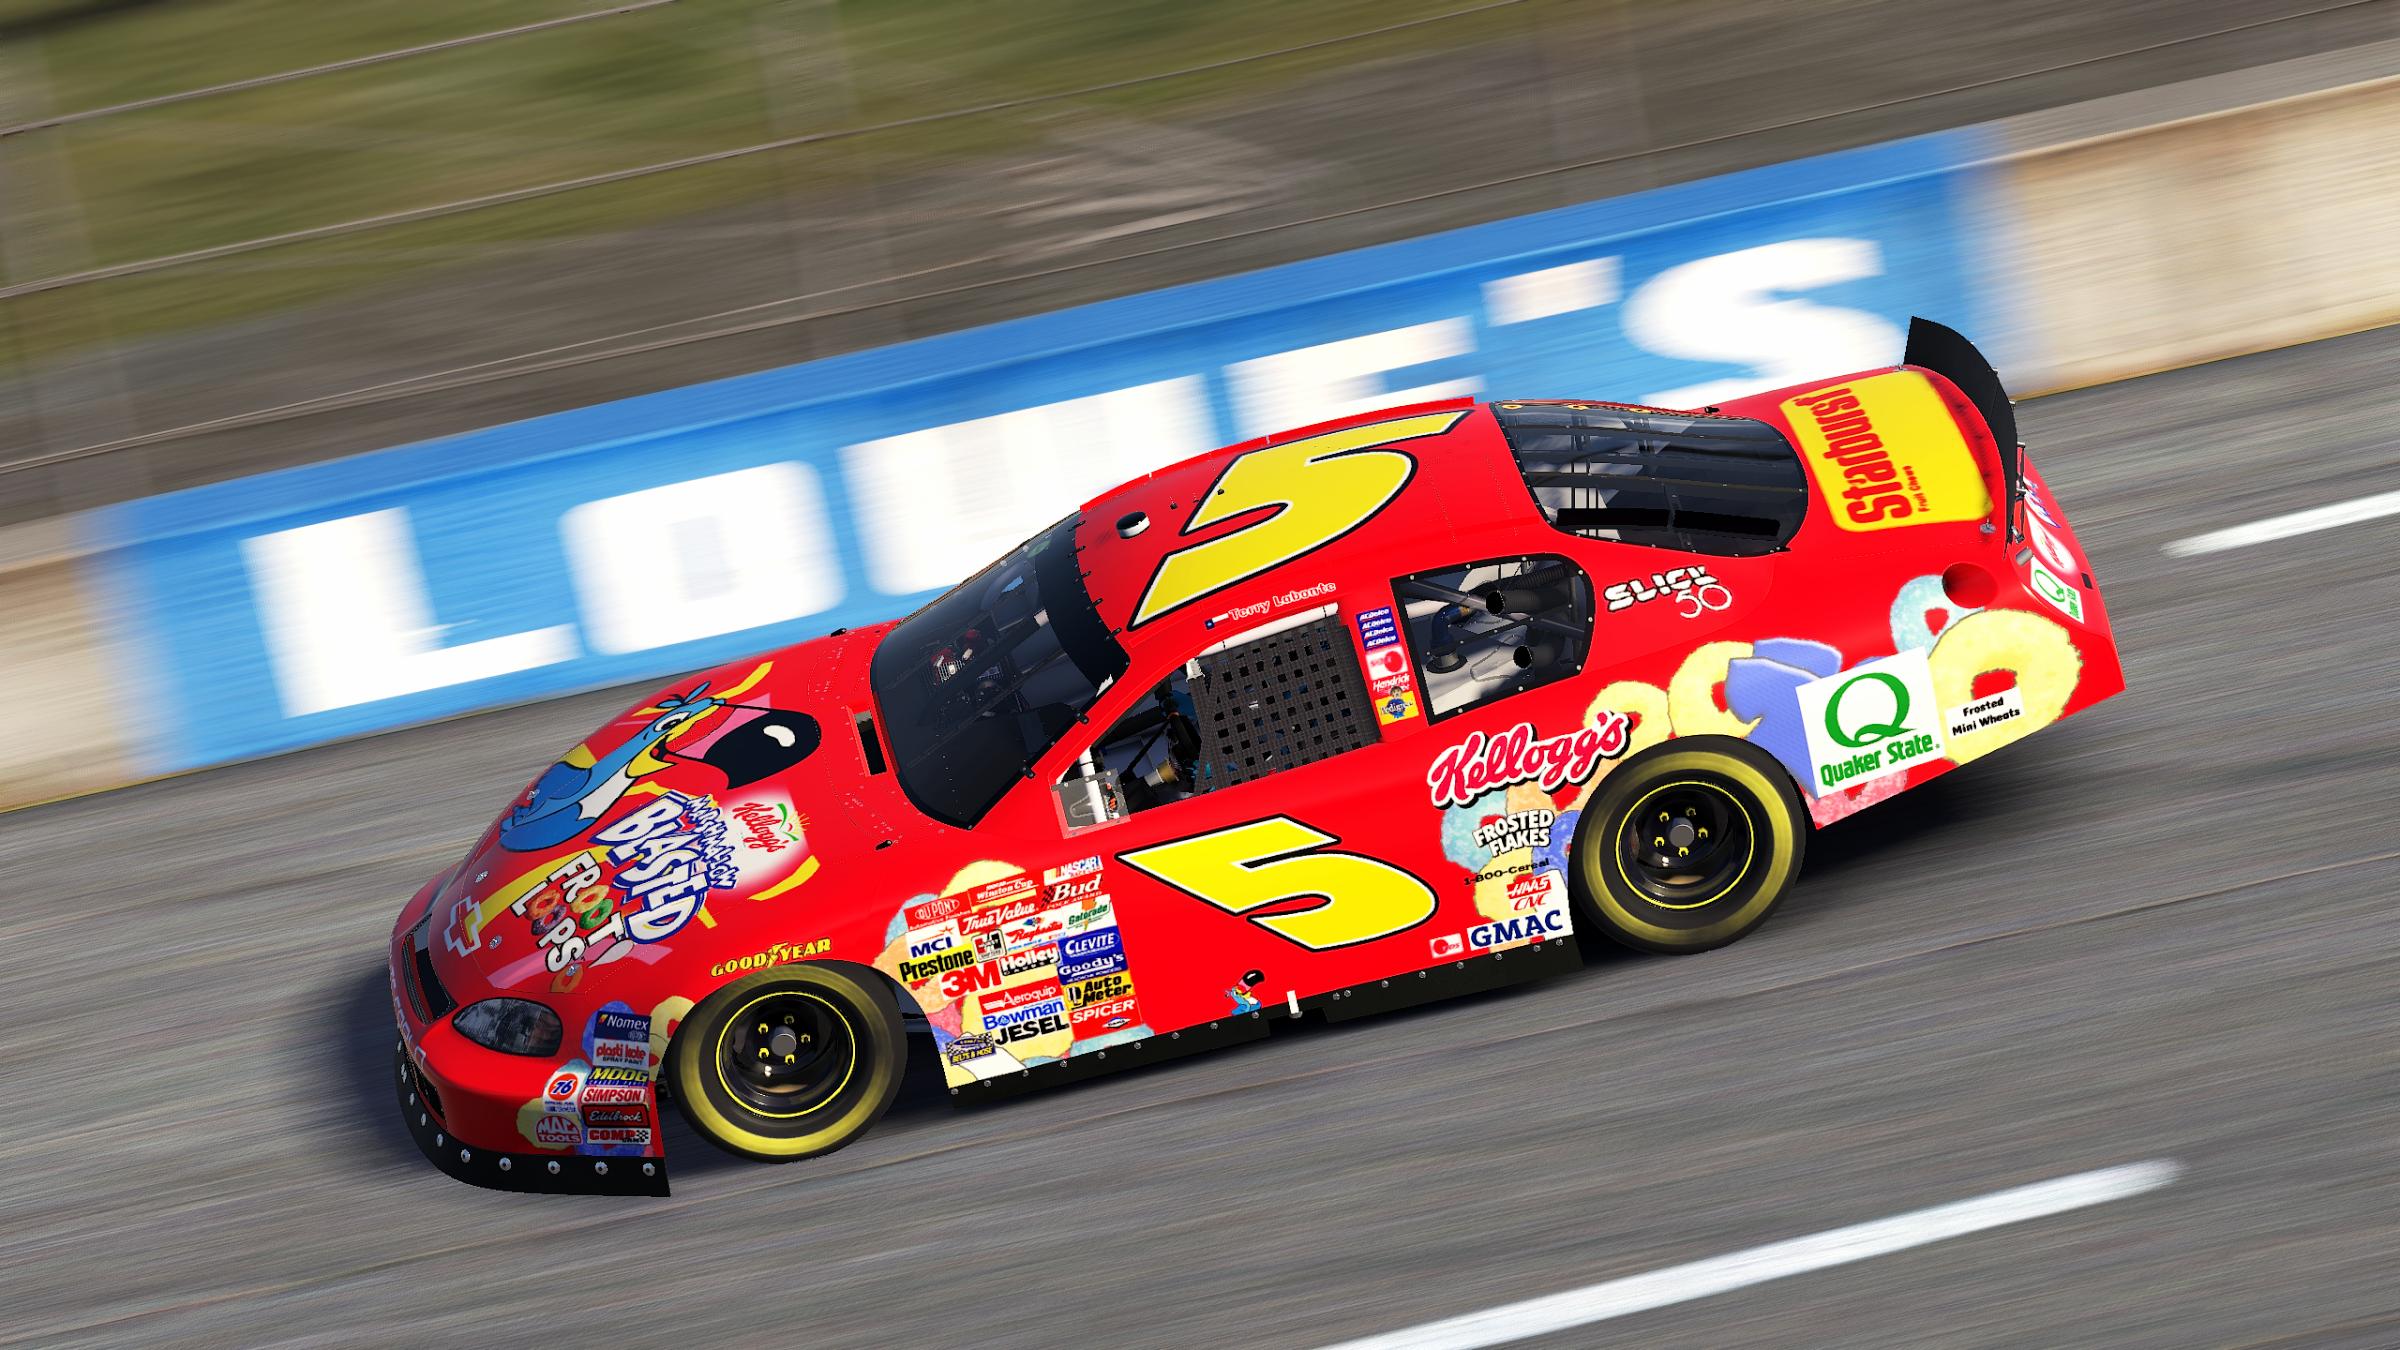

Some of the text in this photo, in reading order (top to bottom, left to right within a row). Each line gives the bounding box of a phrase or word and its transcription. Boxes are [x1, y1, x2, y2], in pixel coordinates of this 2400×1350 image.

[1793, 388, 1912, 523] Starburst
[1127, 409, 1474, 632] 5
[1229, 582, 1336, 621] Terry Labonte
[1604, 566, 1719, 612] SLICK
[1675, 584, 1733, 619] 50
[1373, 673, 1410, 692] Hendrick
[1962, 696, 2004, 717] Frosted
[1952, 708, 2021, 736] Mini Wheats
[1429, 710, 1628, 806] Kellogg's
[1820, 734, 1933, 787] Quaker State
[733, 803, 790, 853] Kellogg's
[1473, 809, 1555, 847] FROSTED
[1489, 828, 1551, 858] FLAKES
[591, 790, 706, 945] BLASTED
[1464, 858, 1550, 886] 1-800-Cereal
[976, 879, 1033, 900] Winston Cup
[1052, 874, 1102, 902] Bud
[1114, 813, 1439, 953] 5
[1509, 878, 1549, 896] HAAS
[547, 851, 627, 948] FROOT
[1514, 892, 1551, 911] CNC
[510, 880, 587, 973] LOOPS
[1068, 904, 1108, 925] Gatorade
[1471, 910, 1563, 948] GMAC
[710, 937, 832, 977] GOODYEAR
[910, 936, 953, 958] MCI
[1065, 933, 1115, 955] CLEVITE
[899, 949, 974, 981] Prestone
[1001, 946, 1060, 972] Holley
[1059, 953, 1124, 976] Goody's
[941, 960, 1001, 998] 3M
[1084, 975, 1122, 992] Auto
[1003, 985, 1057, 1006] Aeroquip
[1082, 984, 1132, 1004] Meter
[607, 1015, 649, 1030] Nomex
[983, 1000, 1064, 1030] Bowman
[1072, 999, 1136, 1024] SPICER
[994, 1015, 1069, 1045] JESEL
[596, 1042, 623, 1057] plasti
[551, 1080, 576, 1095] 76
[584, 1088, 642, 1103] SIMPSON
[537, 1117, 578, 1135] MAC
[589, 1110, 643, 1122] Edelbrock
[538, 1133, 581, 1144] TOOLS
[589, 1129, 637, 1141] COMP
